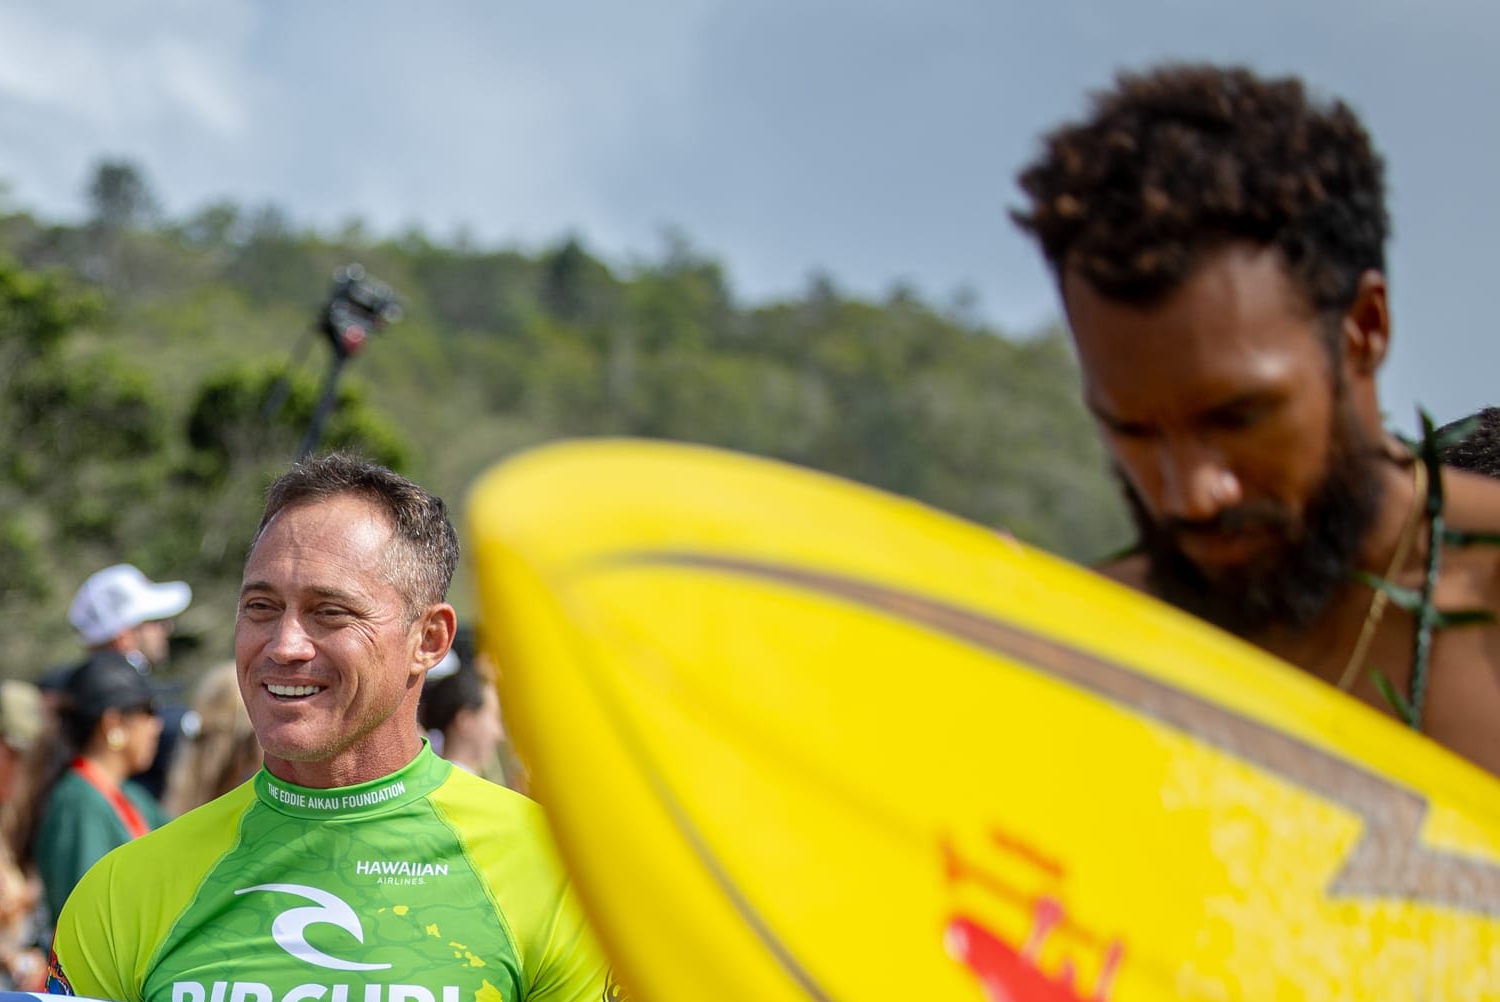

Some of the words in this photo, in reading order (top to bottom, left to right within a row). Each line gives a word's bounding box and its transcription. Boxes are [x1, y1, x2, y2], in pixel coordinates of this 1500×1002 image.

[267, 783, 279, 800] THE
[280, 790, 305, 808] EDDIE
[308, 796, 339, 809] AIKAU
[342, 781, 405, 809] FOUNDATION
[356, 861, 448, 876] HAWAIIAN
[377, 877, 425, 886] AIRLINES
